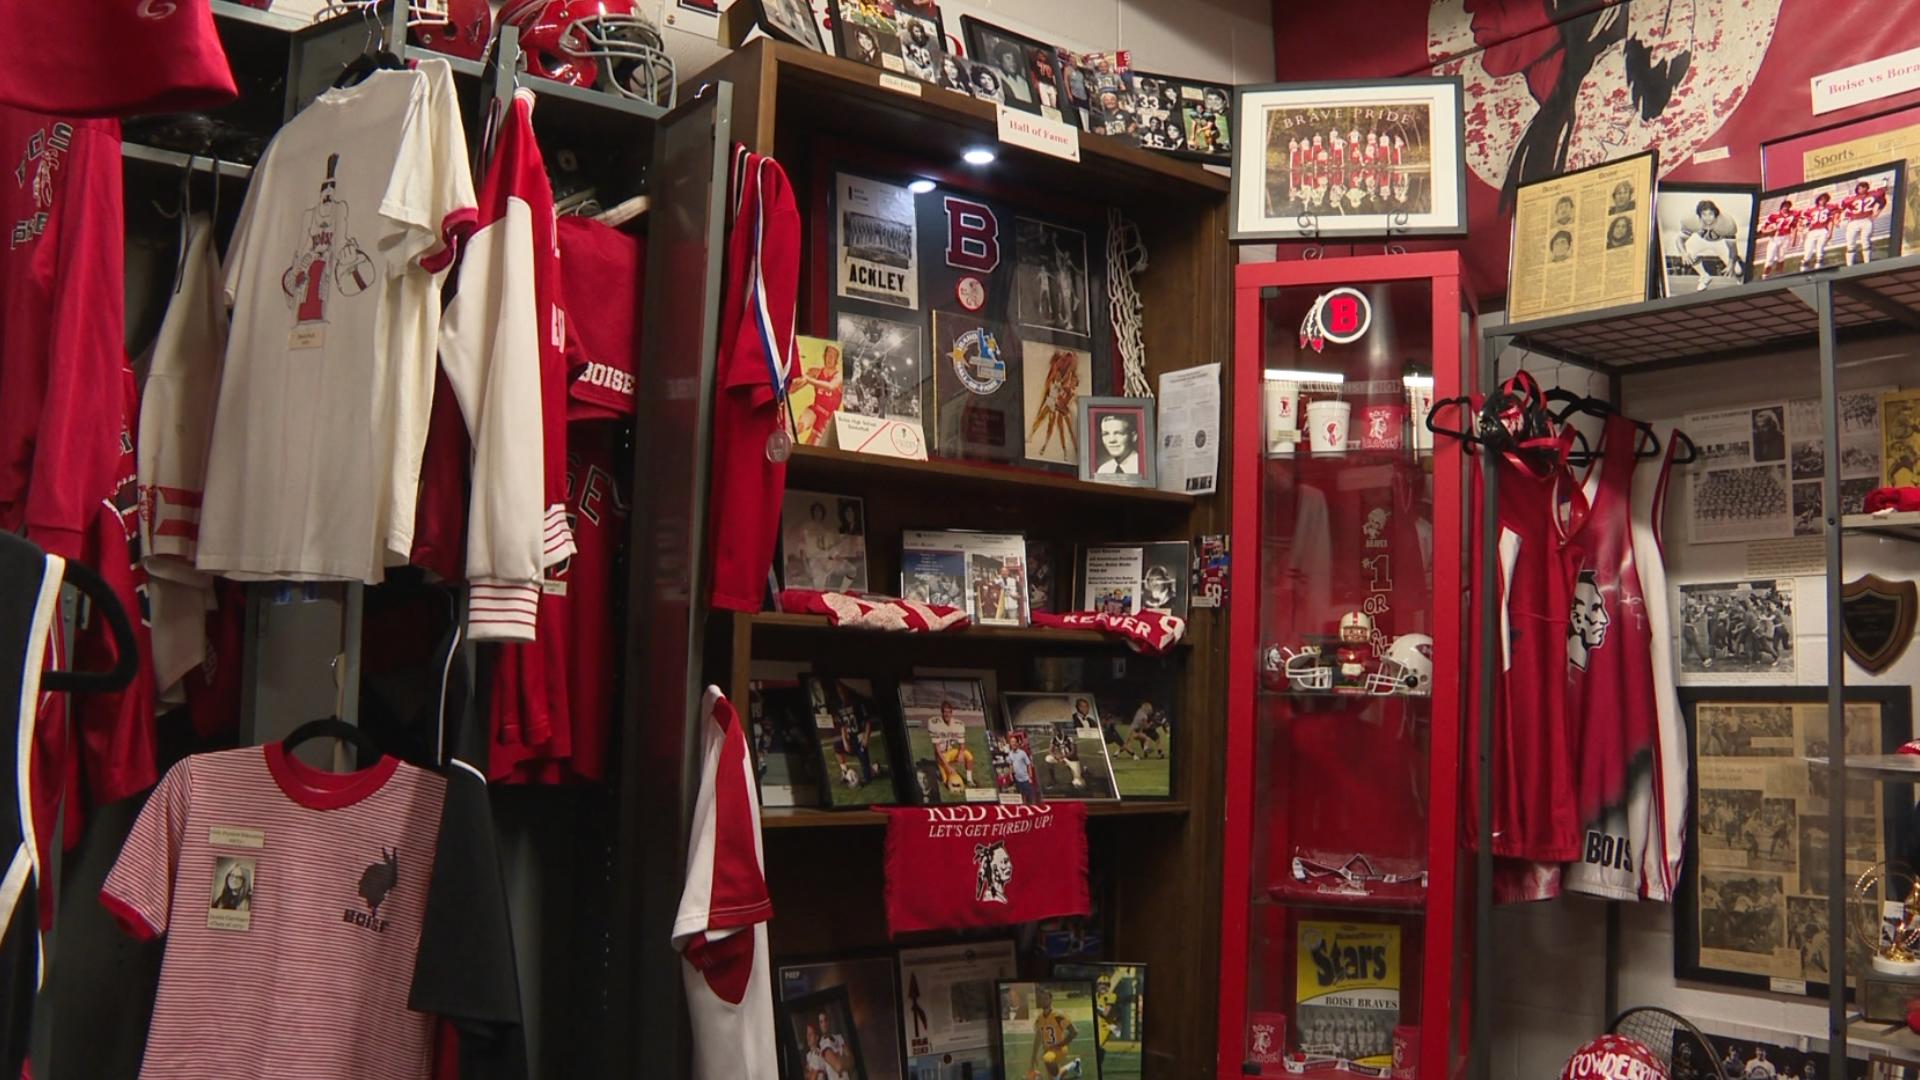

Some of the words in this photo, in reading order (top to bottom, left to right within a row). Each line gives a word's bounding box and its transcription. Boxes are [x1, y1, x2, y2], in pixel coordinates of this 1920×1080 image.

[1828, 79, 1865, 95] Boise
[1869, 75, 1883, 83] vs
[1283, 109, 1343, 128] BRAVE
[1354, 108, 1411, 125] PRIDE
[1009, 120, 1030, 134] Hall
[1032, 127, 1042, 137] of
[1043, 130, 1069, 145] Fame
[1814, 149, 1854, 168] Sports
[1811, 209, 1828, 223] 36
[1852, 197, 1875, 212] 32
[944, 195, 1000, 273] B
[1775, 216, 1794, 230] 77
[850, 263, 905, 292] ACKLEY
[1329, 298, 1359, 333] B
[578, 361, 636, 394] BOISE
[1364, 594, 1389, 614] OR
[1063, 613, 1152, 638] KEEVER
[929, 824, 963, 838] LET'S
[965, 824, 990, 837] GET
[992, 821, 1032, 837] FI(RED)
[1035, 815, 1054, 830] UP!
[1586, 831, 1634, 873] BOIS
[1311, 939, 1387, 987] Stars
[1326, 996, 1354, 1006] BOISE
[1358, 998, 1398, 1009] BRAVES
